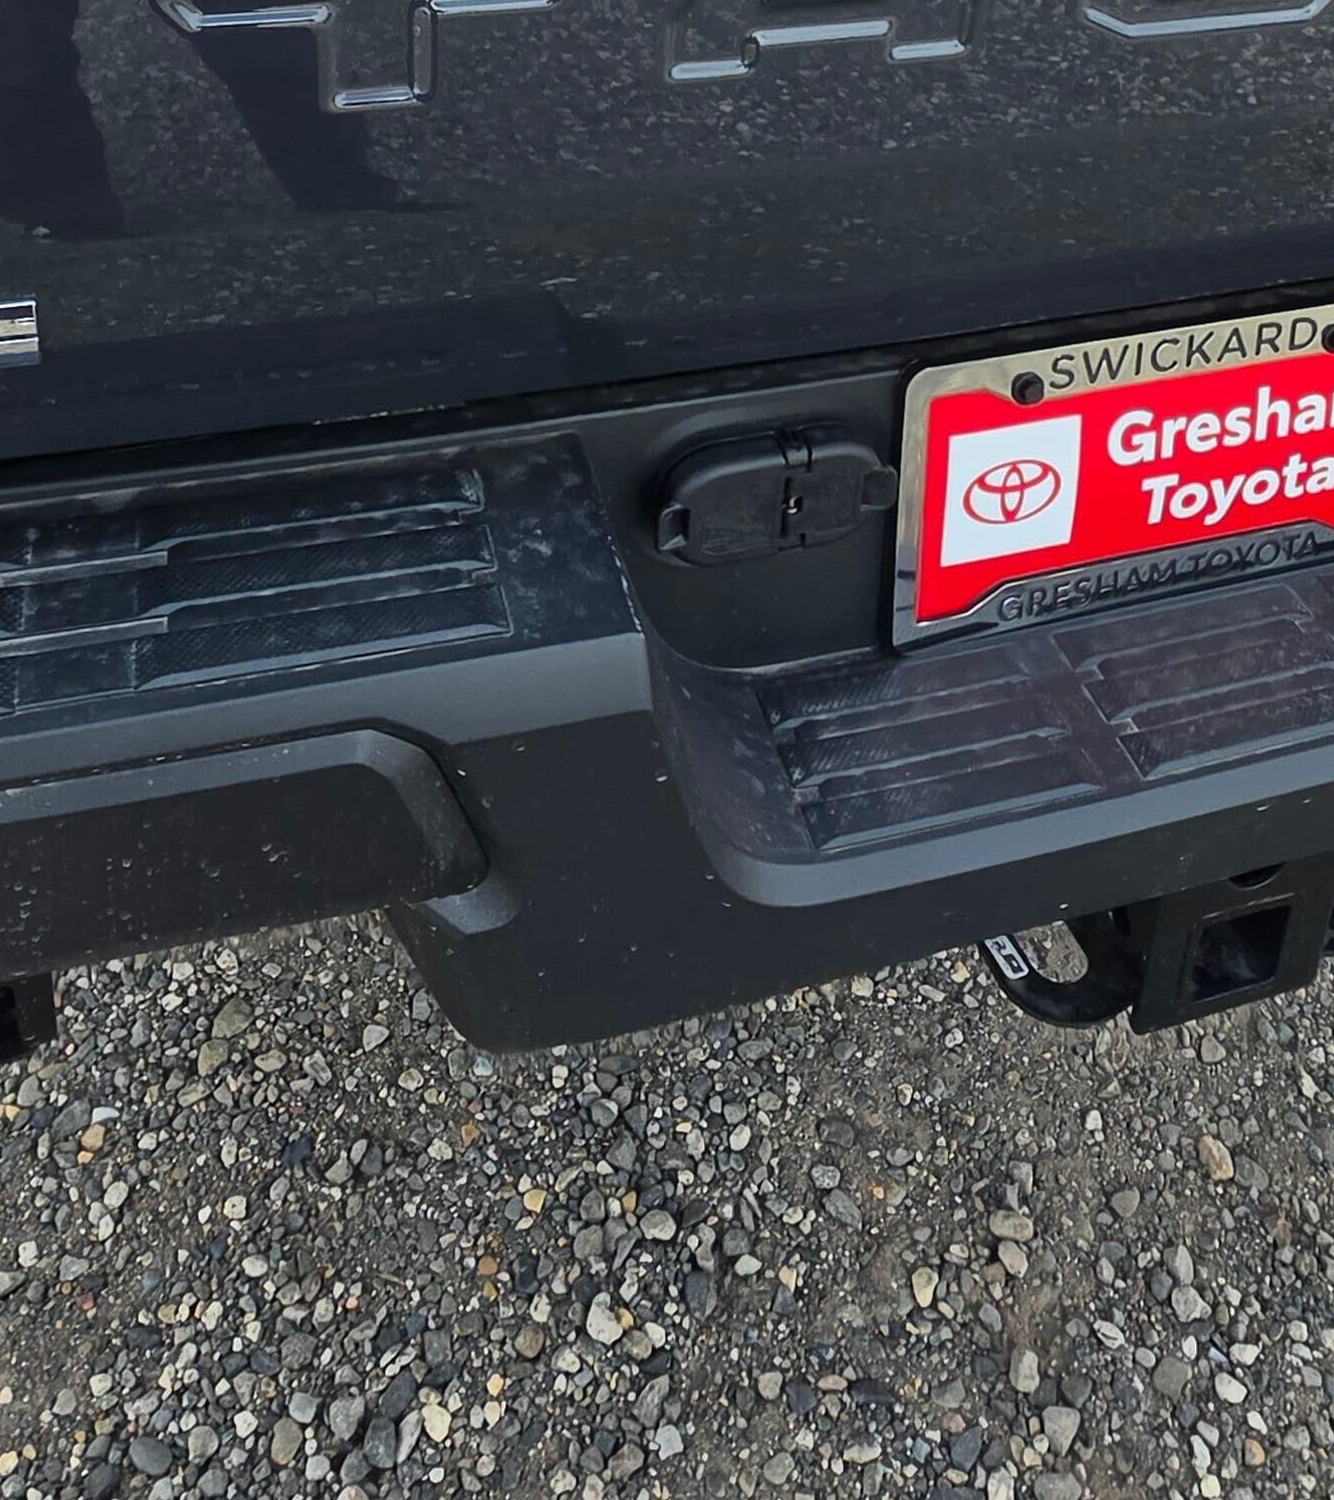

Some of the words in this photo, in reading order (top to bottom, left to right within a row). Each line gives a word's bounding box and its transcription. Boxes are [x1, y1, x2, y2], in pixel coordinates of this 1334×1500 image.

[1049, 316, 1319, 391] SWICKARD
[996, 561, 1183, 624] GRESHAM
[1184, 530, 1321, 581] TOYOTA
